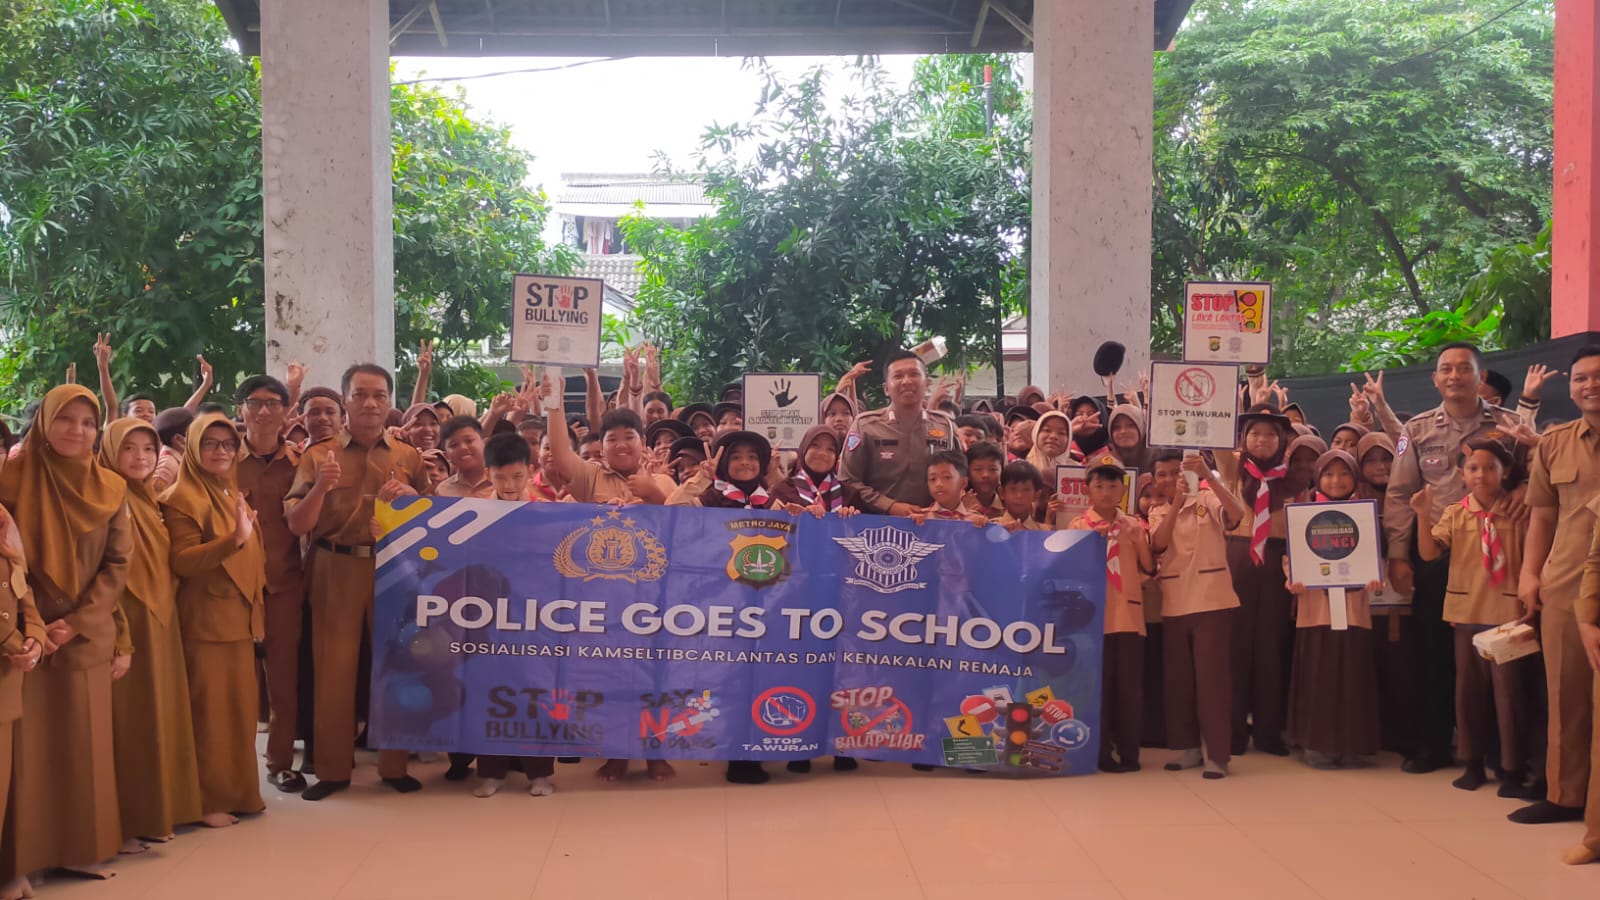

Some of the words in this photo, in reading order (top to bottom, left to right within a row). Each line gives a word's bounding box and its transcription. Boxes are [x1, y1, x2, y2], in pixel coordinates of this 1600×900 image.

[1191, 293, 1235, 311] STOP
[525, 308, 588, 324] BULLYING
[1184, 410, 1231, 418] TAWURAN
[1061, 477, 1088, 495] STO
[729, 520, 766, 529] METRO
[767, 521, 791, 531] JAYA
[416, 595, 606, 632] POLICE
[621, 602, 766, 637] GOES
[781, 607, 843, 639] TO
[857, 610, 1066, 654] SCHOOL
[449, 641, 570, 657] SOSIALISASI
[578, 646, 798, 664] KAMSELTIBCARLANTAS
[806, 651, 835, 664] DAN
[843, 653, 951, 670] KENAKALAN
[959, 660, 1033, 677] REMAJA
[640, 690, 693, 708] SAY
[830, 686, 893, 709] STOP
[1045, 703, 1068, 721] STOP
[485, 720, 604, 740] BULLYING
[639, 706, 704, 742] NO
[743, 743, 818, 752] TAWURAN
[763, 737, 802, 745] STOP
[835, 736, 884, 751] BALAP
[888, 734, 925, 750] LIAR
